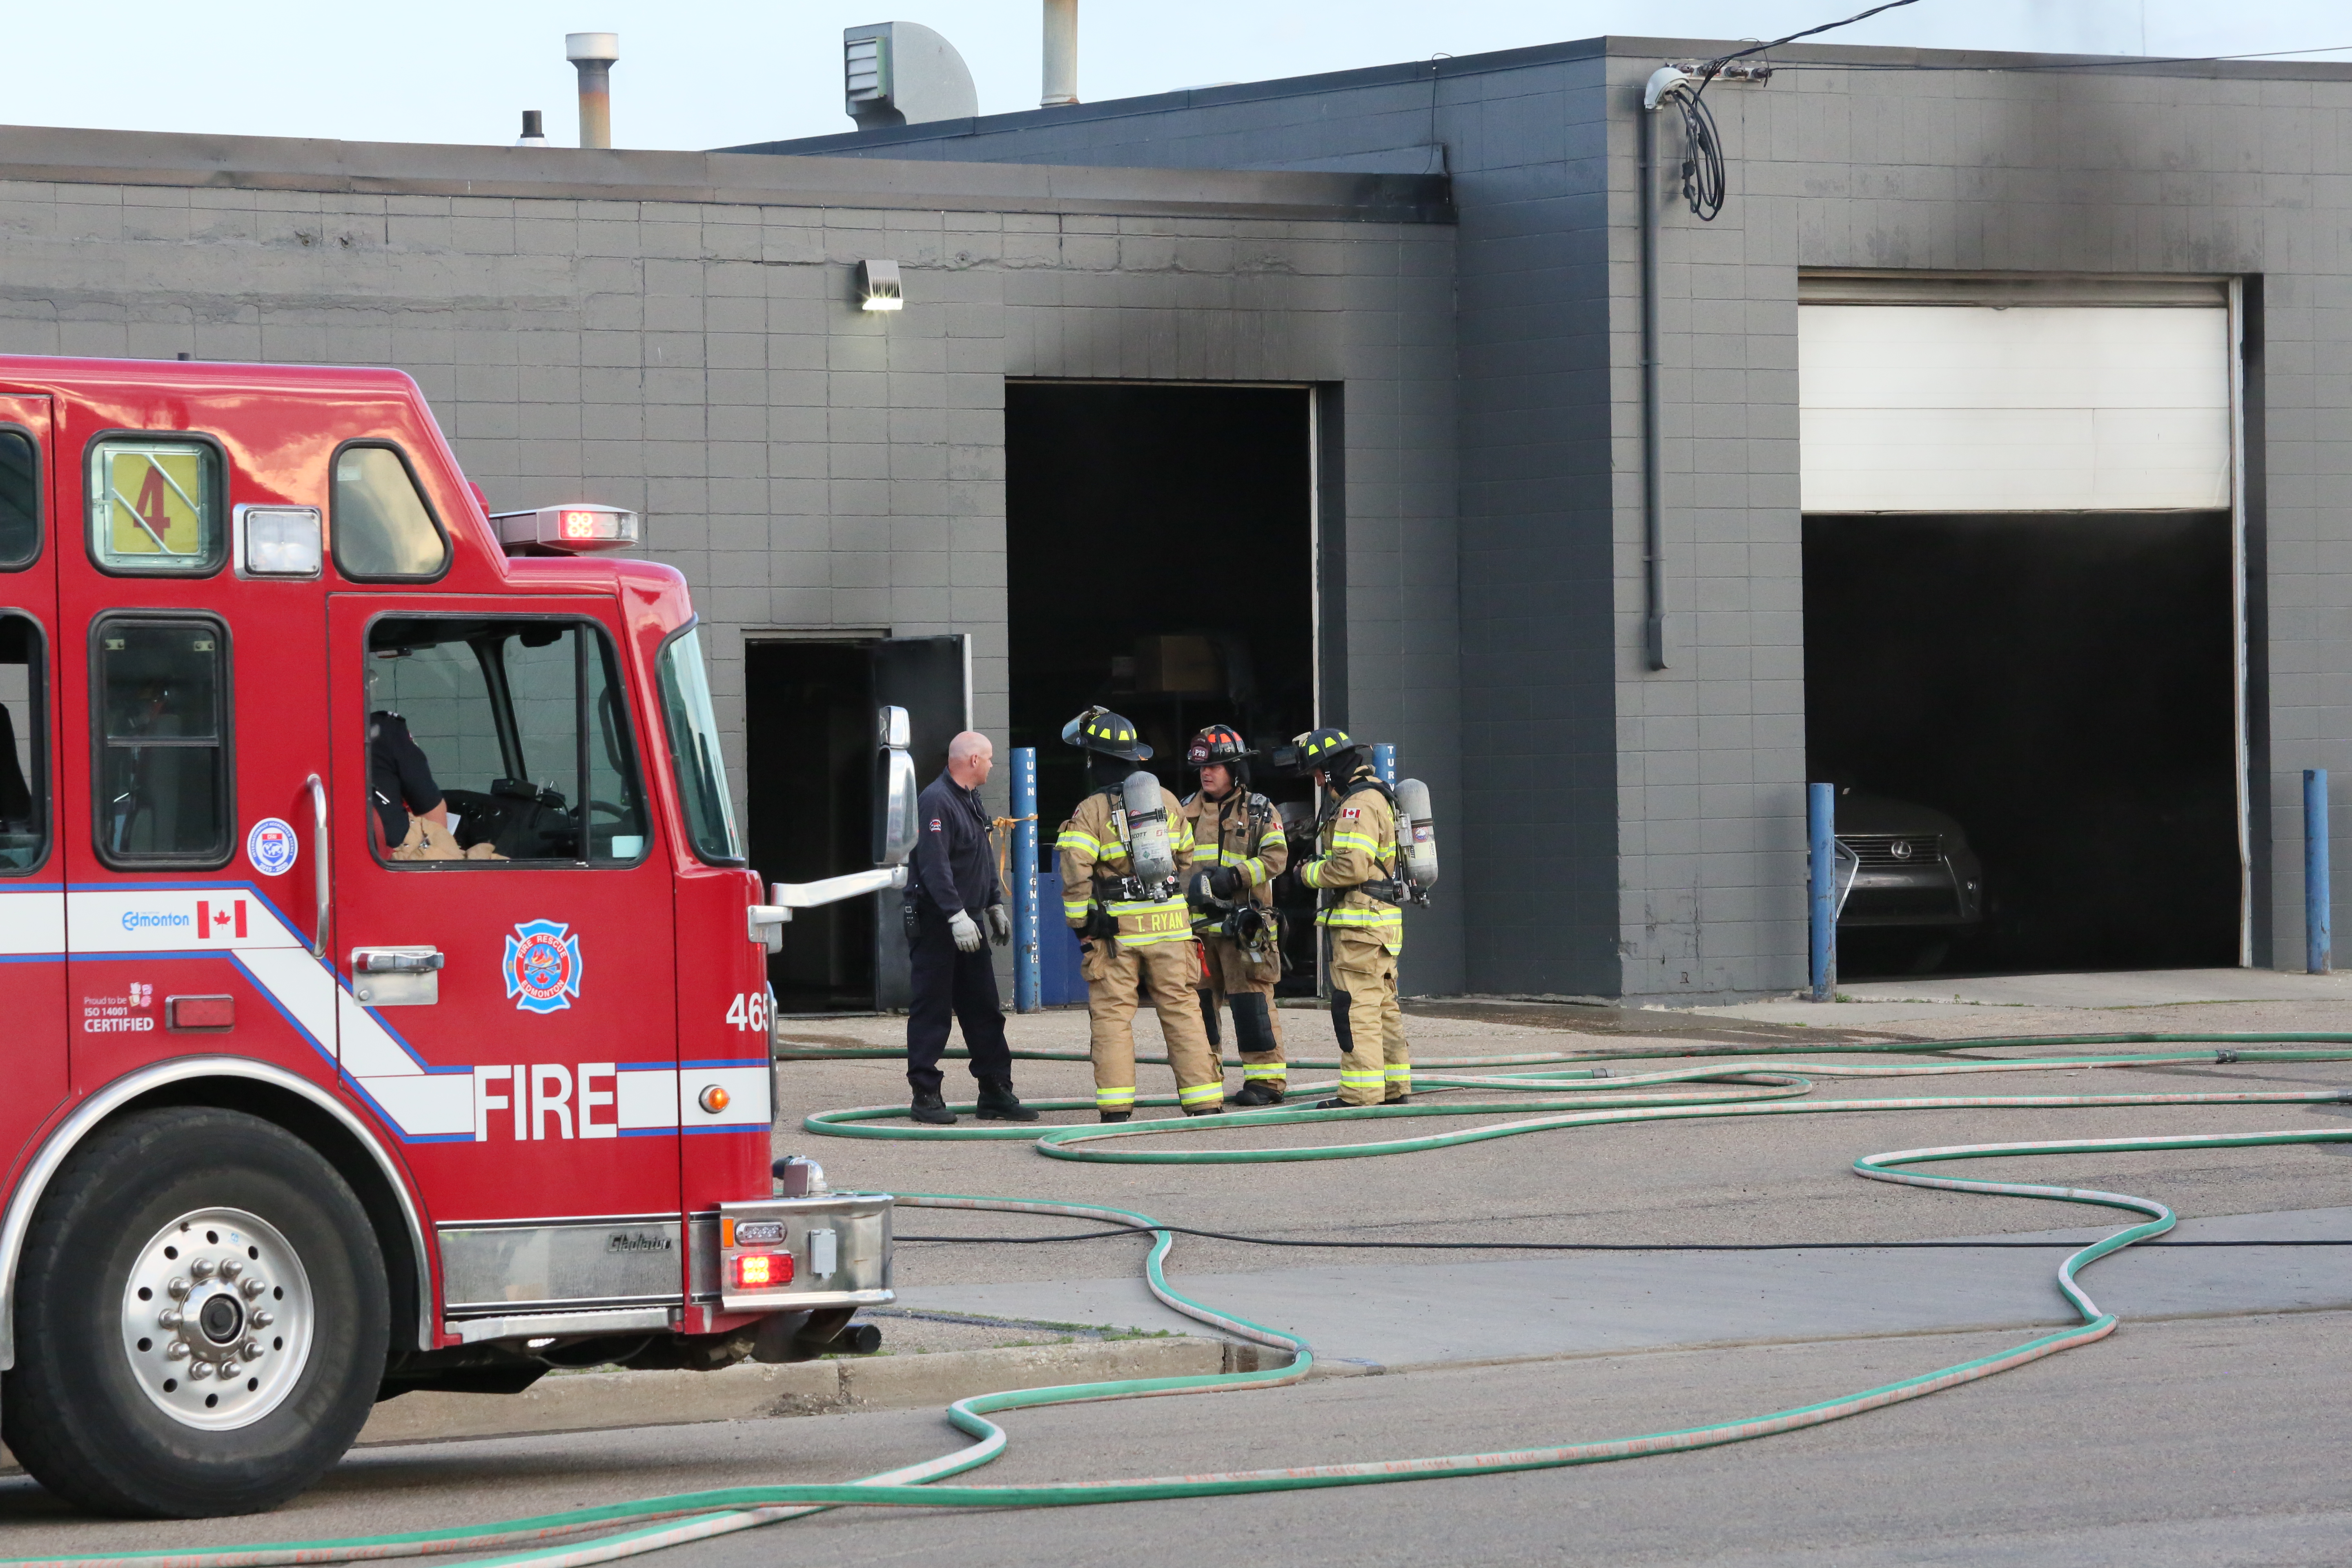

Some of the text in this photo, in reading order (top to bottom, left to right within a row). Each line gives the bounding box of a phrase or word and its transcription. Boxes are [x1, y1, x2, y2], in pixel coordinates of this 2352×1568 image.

[134, 466, 171, 543] 4
[1027, 748, 1035, 795] TURN
[122, 911, 190, 931] Edmonton
[1152, 911, 1184, 931] RYAN
[518, 935, 567, 959] FIRE RESCUE
[521, 979, 565, 998] EDMONTON
[84, 996, 107, 1004] Proud
[117, 996, 127, 1004] be
[84, 1007, 100, 1016] ISO
[102, 1007, 127, 1016] 14001
[84, 1017, 154, 1033] CERTIFIED
[474, 1062, 617, 1142] FIRE
